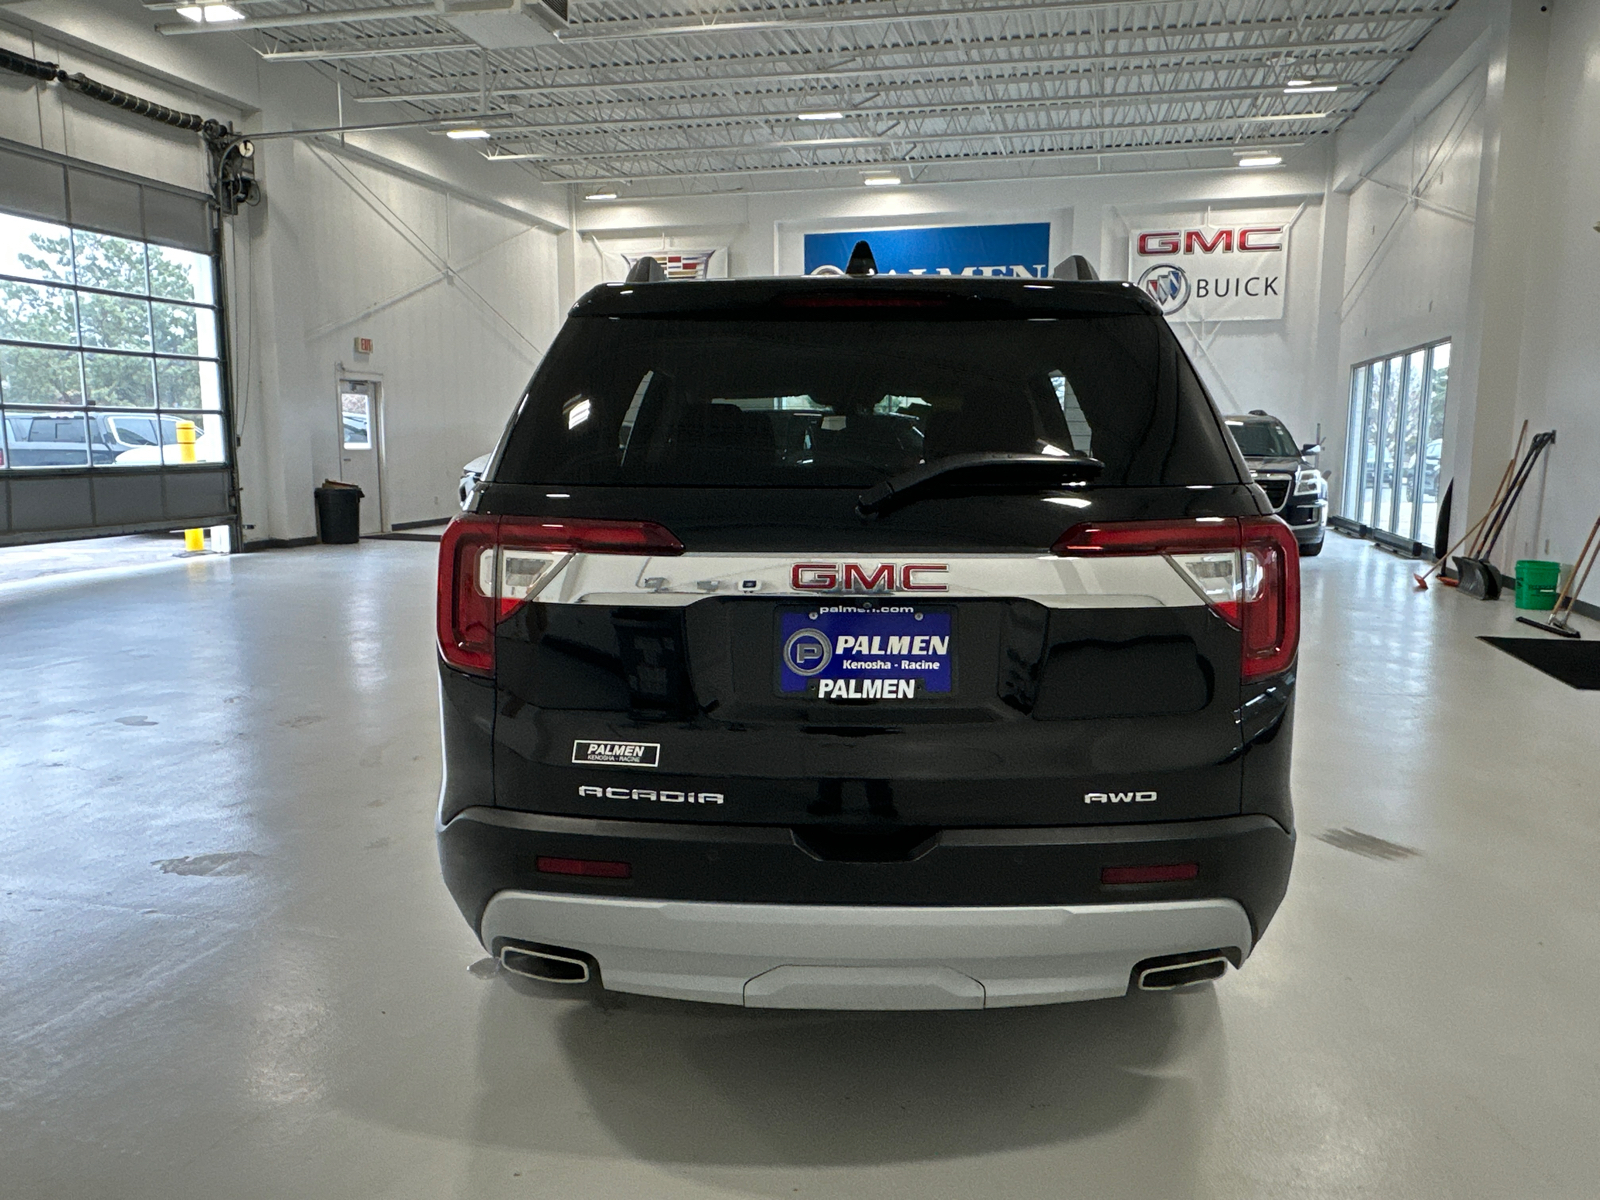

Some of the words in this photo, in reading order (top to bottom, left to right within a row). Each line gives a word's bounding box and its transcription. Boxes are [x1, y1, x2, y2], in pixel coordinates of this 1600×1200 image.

[1137, 226, 1283, 257] GMC
[1196, 276, 1279, 298] BUICK
[789, 562, 950, 593] GMC
[835, 635, 950, 655] PALMEN
[842, 660, 891, 670] Kenosha
[901, 660, 940, 670] Racine
[818, 679, 916, 699] PALMEN
[587, 743, 645, 757] PALMEN
[578, 785, 725, 805] ACADIA
[1084, 791, 1158, 804] AWD
